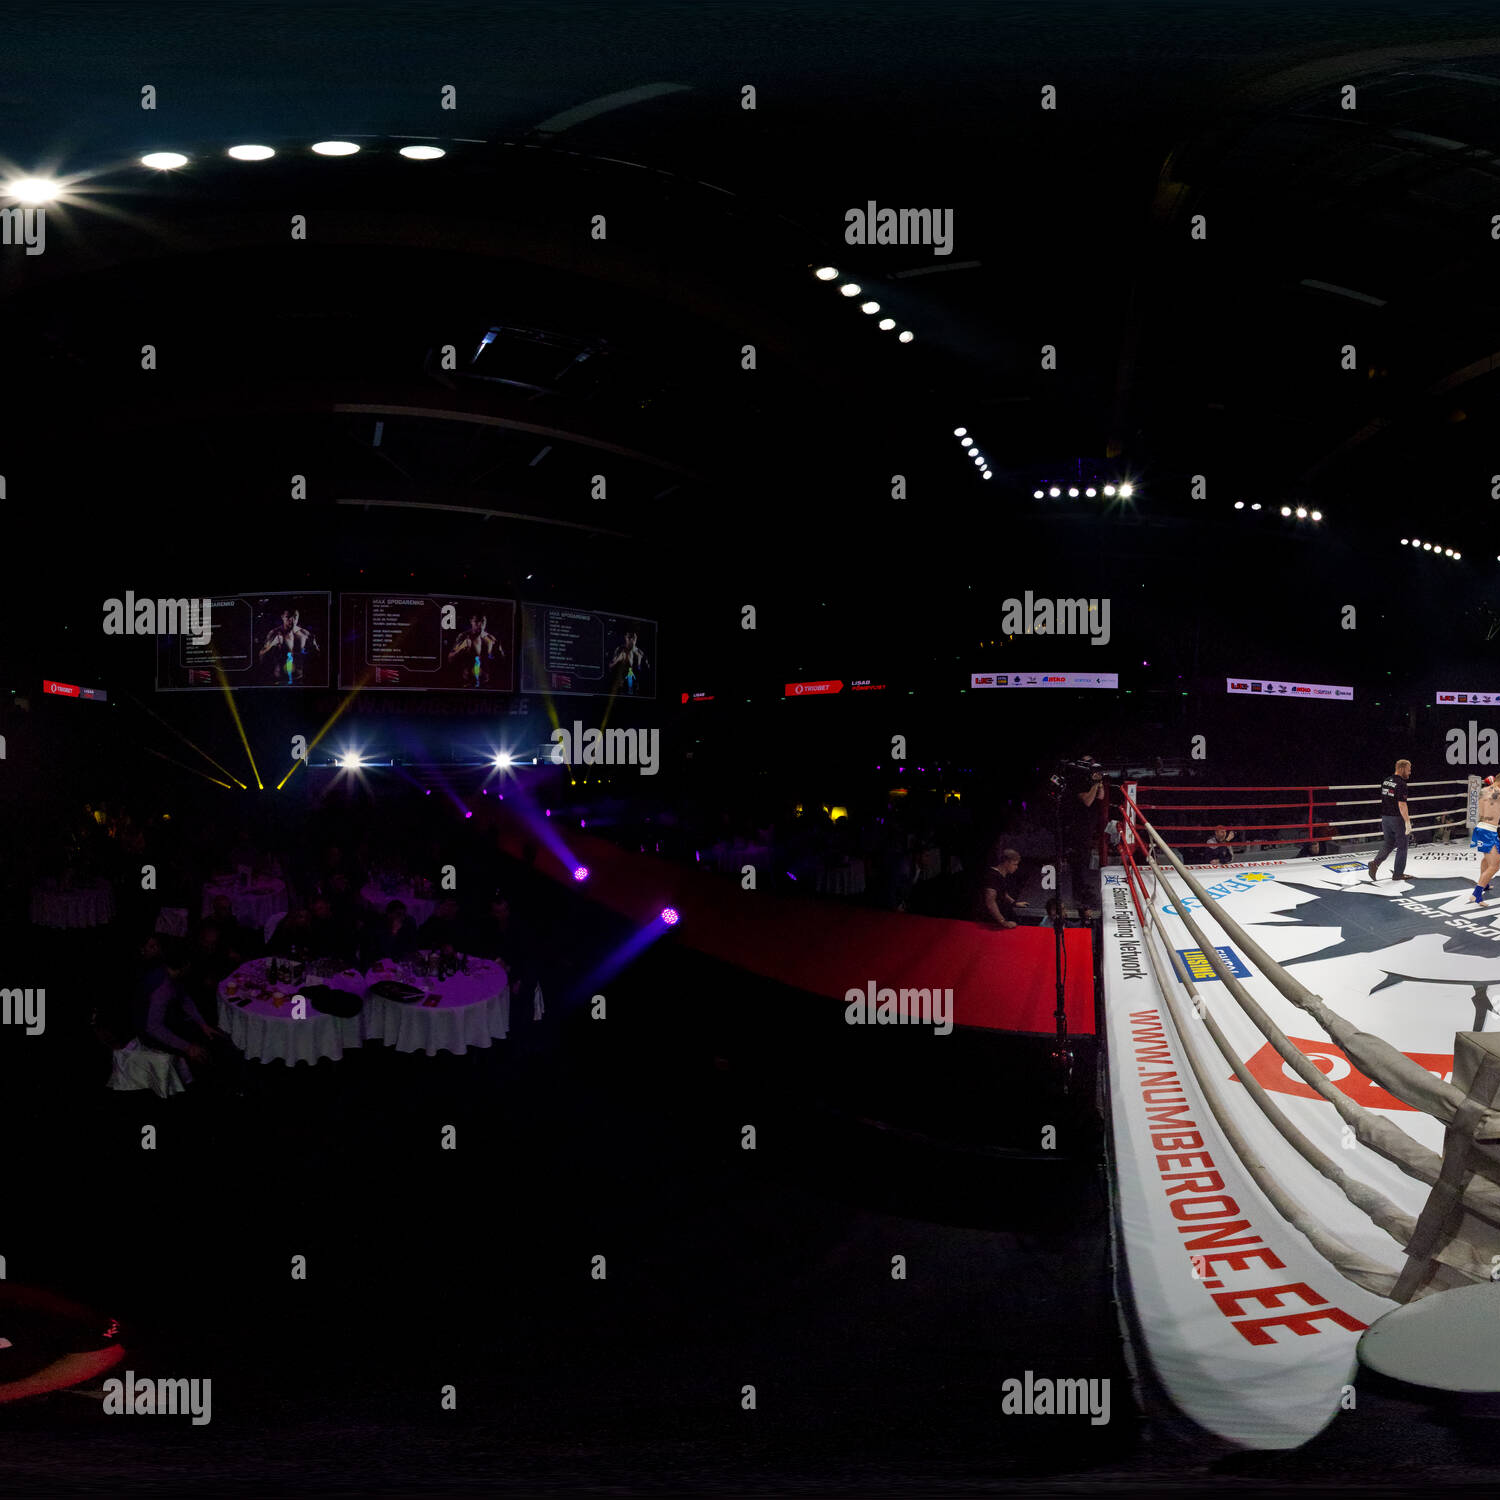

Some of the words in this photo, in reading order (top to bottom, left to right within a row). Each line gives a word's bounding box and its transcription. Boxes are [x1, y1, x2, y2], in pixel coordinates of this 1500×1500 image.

[804, 684, 830, 692] TRIOBET
[1112, 887, 1131, 910] Estonian
[1390, 898, 1453, 919] FIGHT
[1112, 911, 1136, 938] Fighting
[1119, 940, 1148, 980] Network
[1129, 1009, 1369, 1346] WWW.NUMBERONE.EE
